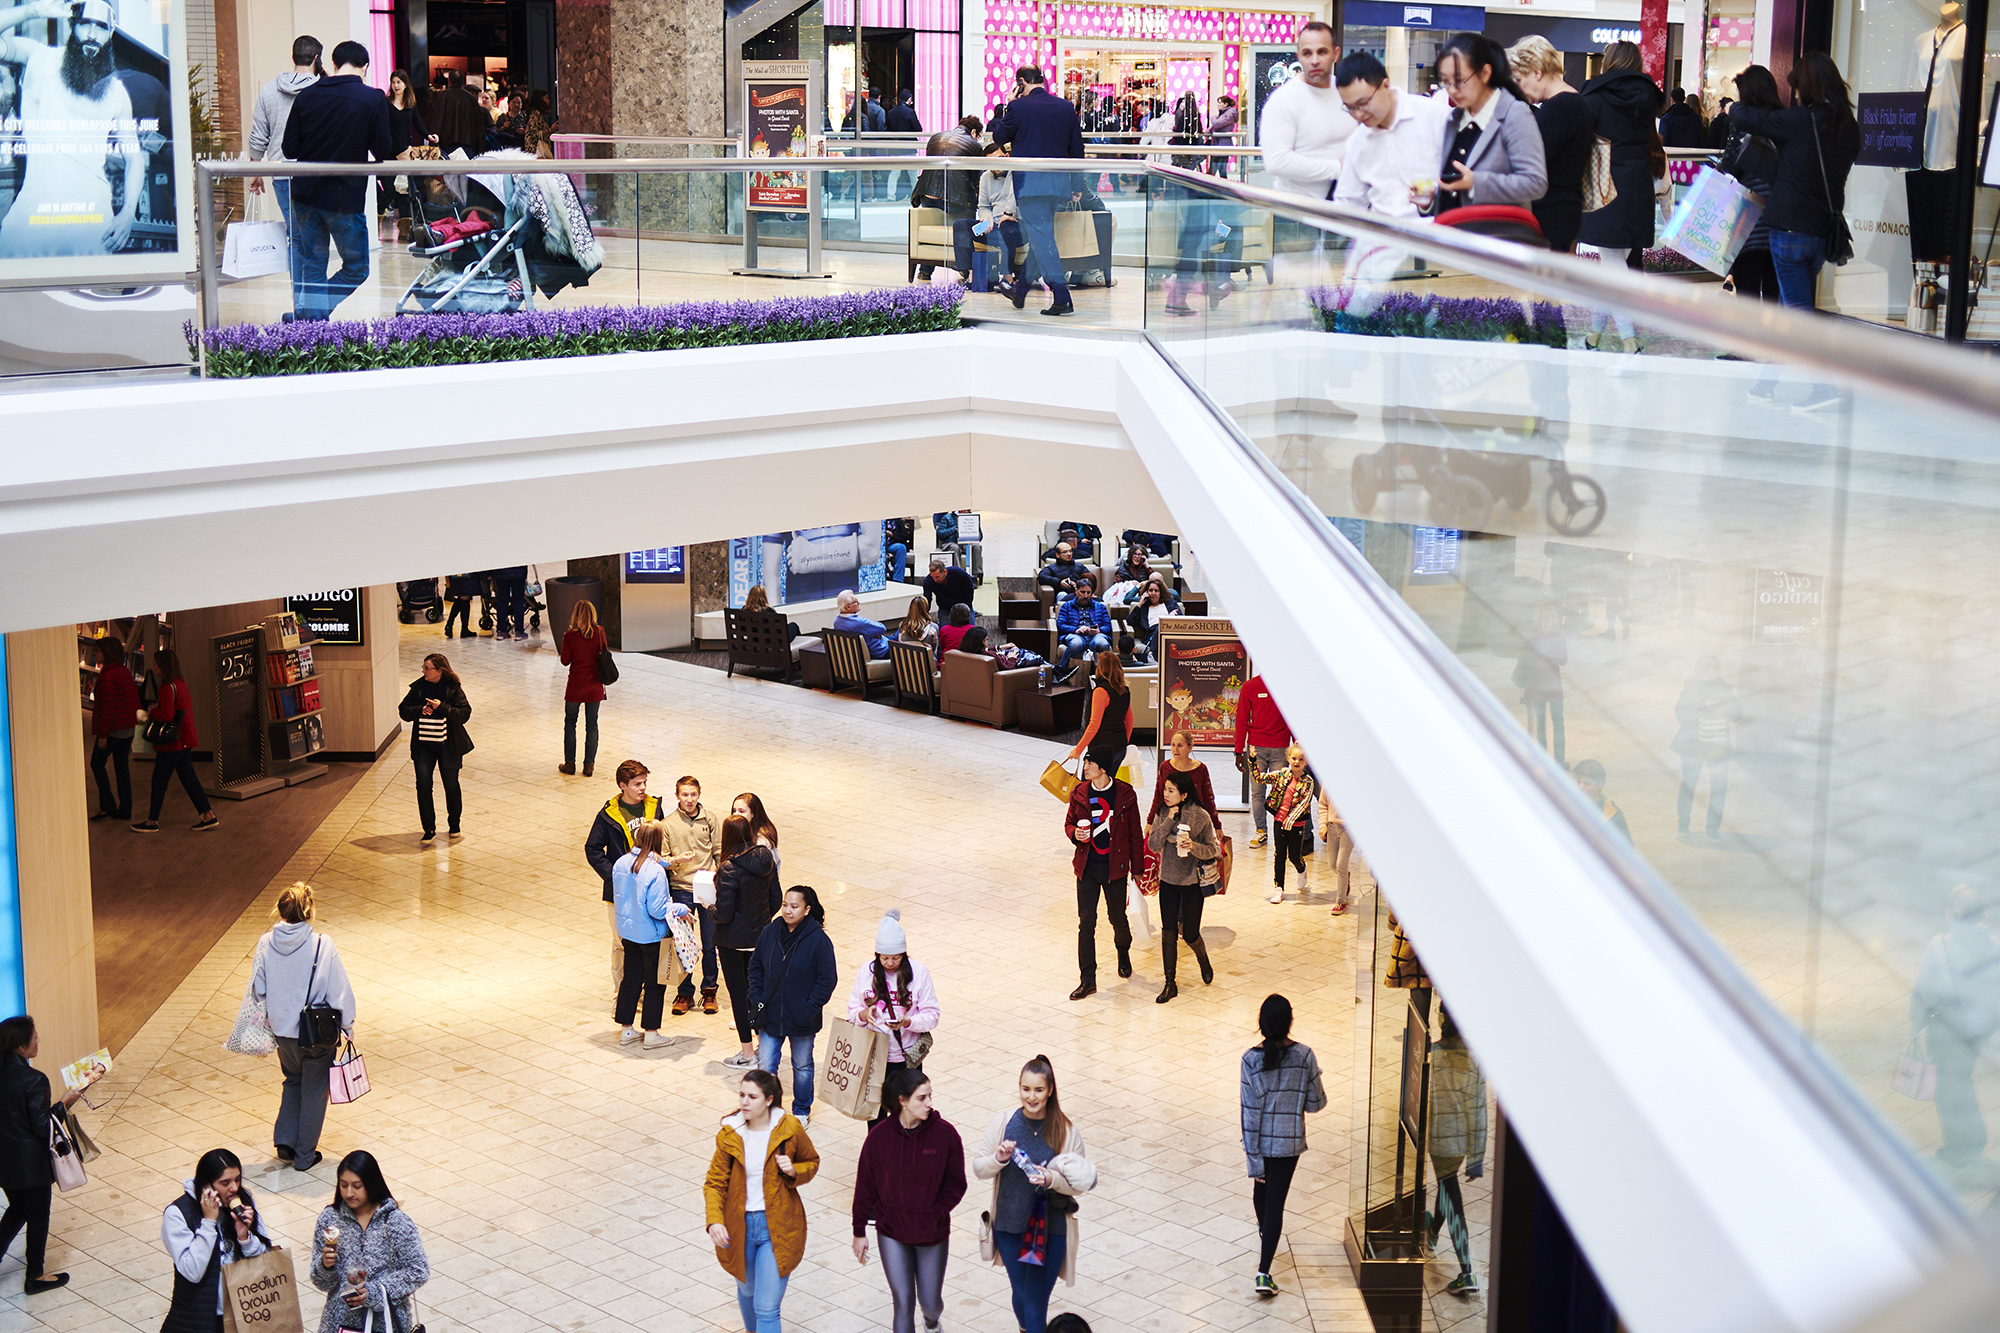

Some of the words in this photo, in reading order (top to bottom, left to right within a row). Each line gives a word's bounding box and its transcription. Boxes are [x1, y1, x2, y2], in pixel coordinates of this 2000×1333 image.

[1123, 11, 1168, 34] PINK
[1591, 28, 1618, 44] COLE
[4, 119, 23, 132] CITY
[25, 119, 67, 131] WELCOMES
[69, 119, 117, 131] WORLDPRIDE
[119, 119, 137, 131] THIS
[138, 118, 159, 131] JUNE
[1863, 107, 1880, 125] Black
[1880, 107, 1898, 131] Friday
[1899, 108, 1917, 125] Event
[14, 143, 55, 154] CELEBRATE
[56, 143, 78, 154] PRIDE
[79, 143, 93, 154] 365
[94, 143, 112, 154] DAYS
[114, 143, 119, 153] A
[121, 143, 140, 154] YEAR
[1876, 130, 1885, 151] off
[1884, 130, 1913, 153] everything
[37, 203, 52, 213] JOIN
[53, 203, 60, 212] IN
[61, 202, 87, 212] ANYTIME
[88, 202, 96, 211] AT
[1697, 207, 1719, 224] OUT
[1702, 198, 1720, 213] AN
[1691, 216, 1712, 234] THIS
[1853, 218, 1874, 232] CLUB
[1875, 221, 1910, 237] MONACO
[1679, 235, 1721, 264] HOLIDAY
[1686, 226, 1722, 252] WORLD
[734, 537, 748, 559] EV
[734, 560, 749, 606] DEAR
[220, 640, 236, 650] BLACK
[237, 637, 255, 647] FRIDAY
[222, 652, 254, 681] 25%
[244, 666, 254, 676] off
[835, 1036, 852, 1059] big
[827, 1066, 849, 1092] bag
[237, 1273, 288, 1298] medium
[239, 1290, 281, 1311] brown
[242, 1308, 272, 1324] bag
